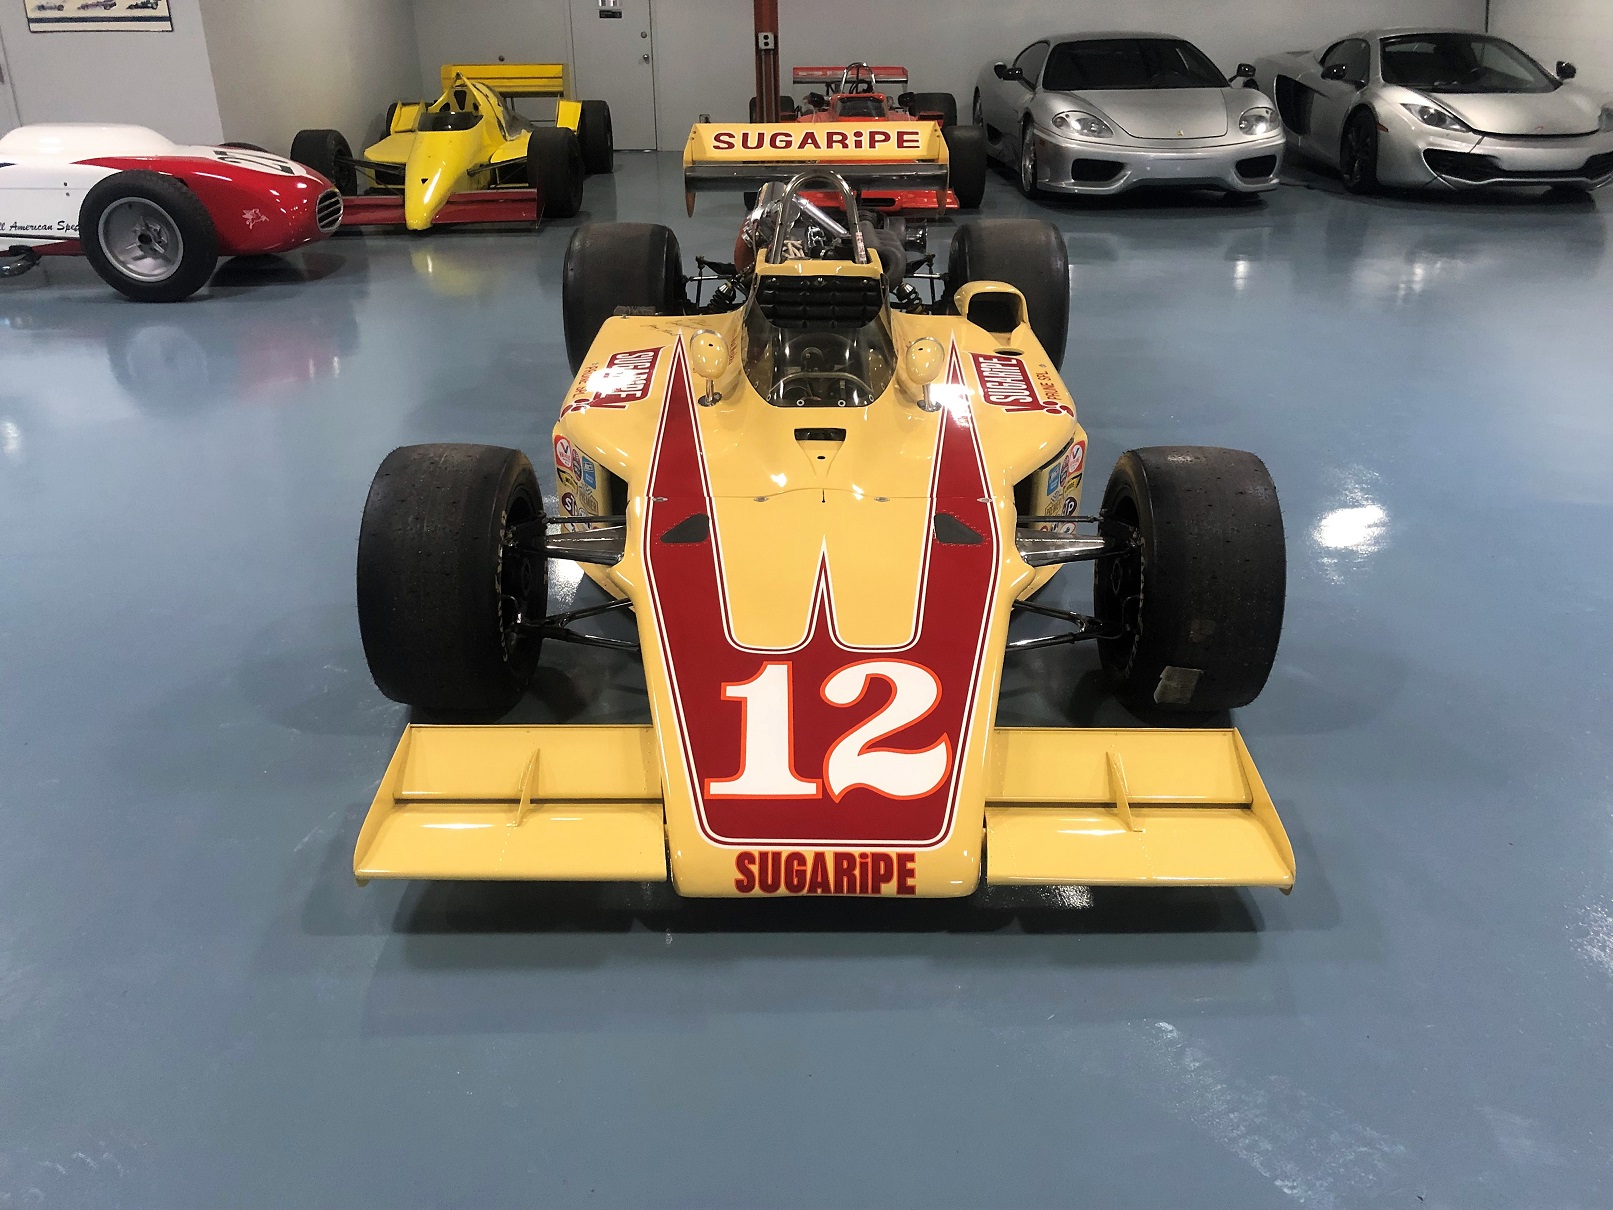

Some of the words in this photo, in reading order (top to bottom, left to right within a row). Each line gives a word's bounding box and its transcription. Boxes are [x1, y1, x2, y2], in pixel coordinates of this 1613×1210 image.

[9, 221, 53, 231] American
[1039, 381, 1062, 401] PRUNE
[704, 657, 953, 804] 12
